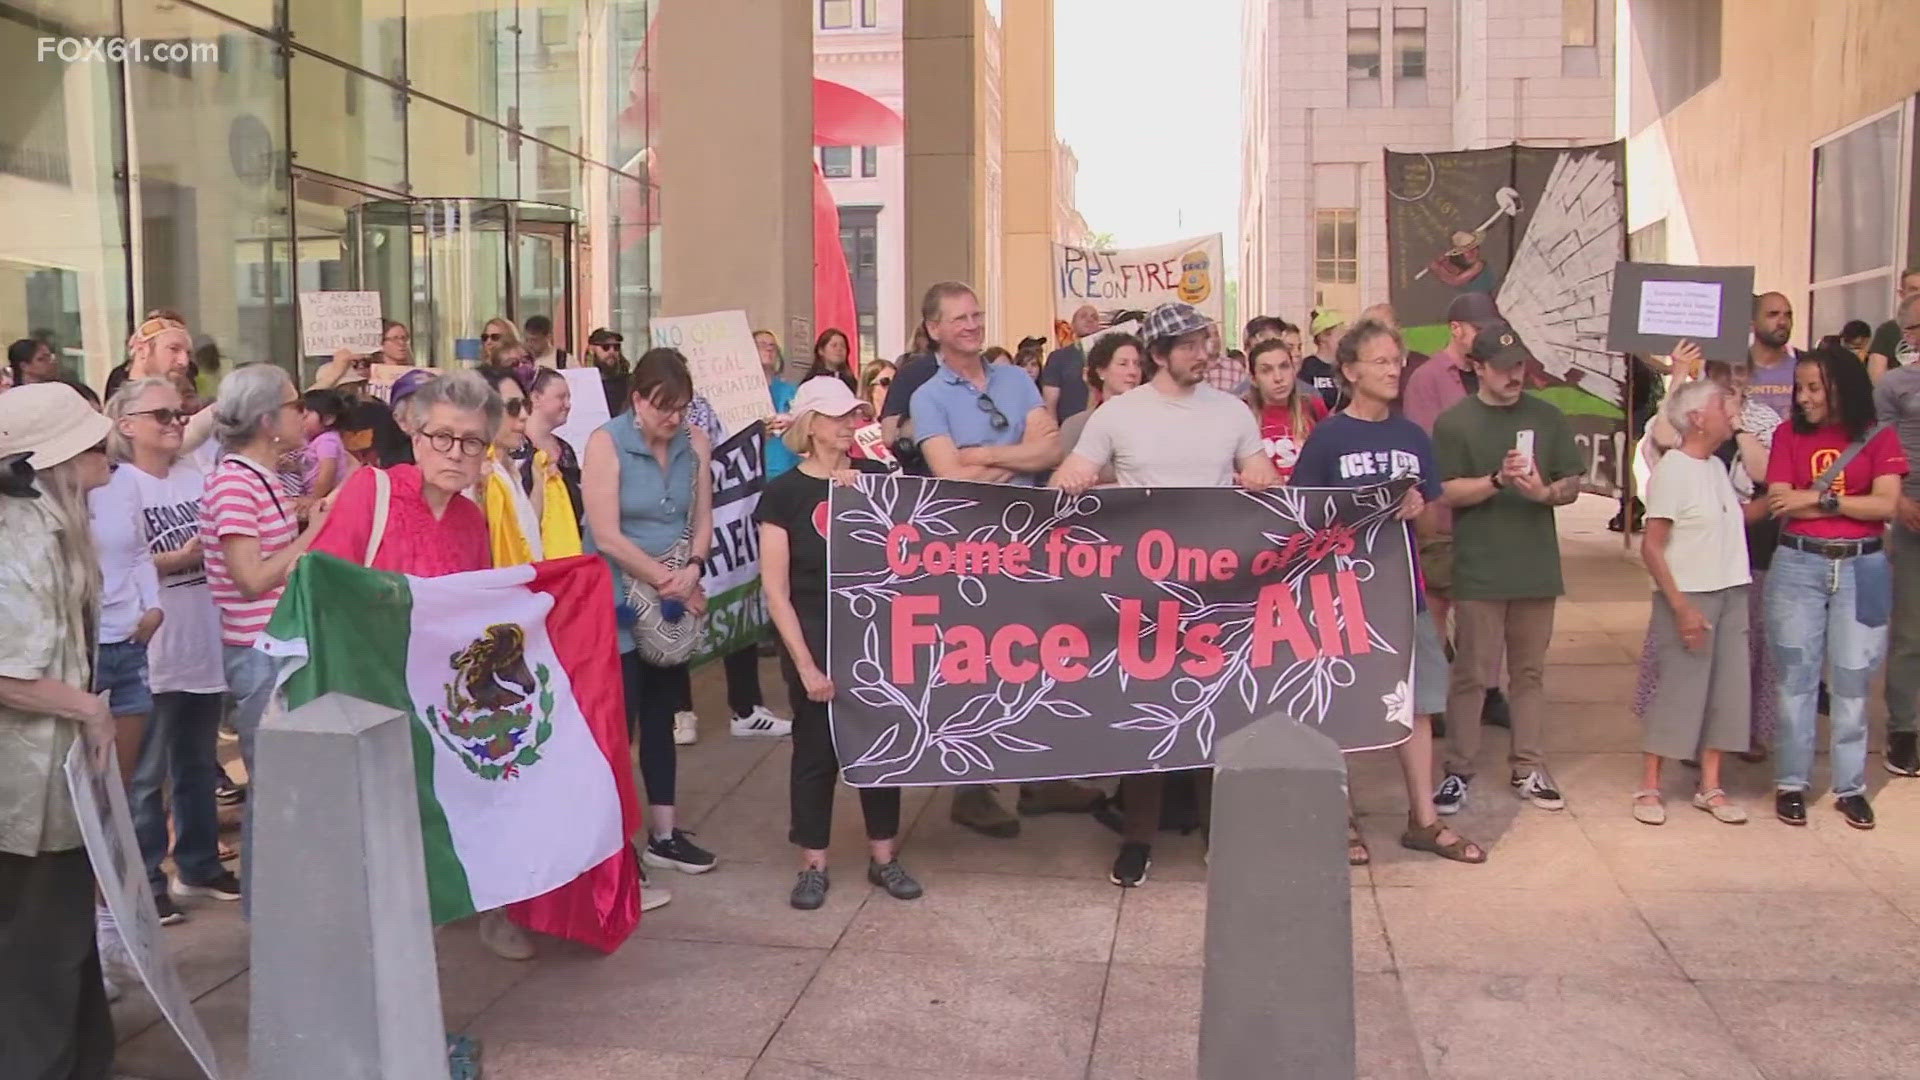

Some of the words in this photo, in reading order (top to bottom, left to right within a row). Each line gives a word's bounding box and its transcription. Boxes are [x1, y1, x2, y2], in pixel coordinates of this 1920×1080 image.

[1065, 247, 1117, 274] PUT
[1060, 267, 1101, 298] ICE
[1102, 281, 1127, 299] ON
[1120, 259, 1179, 293] FIRE
[655, 326, 683, 347] NO
[1313, 376, 1335, 389] ICE
[1339, 450, 1377, 479] ICE
[886, 523, 1030, 577] Come
[1045, 527, 1123, 578] for
[1136, 529, 1239, 582] One
[1251, 532, 1307, 576] of
[889, 594, 1092, 684] Face
[1118, 599, 1227, 681] Us
[1250, 570, 1370, 669] All
